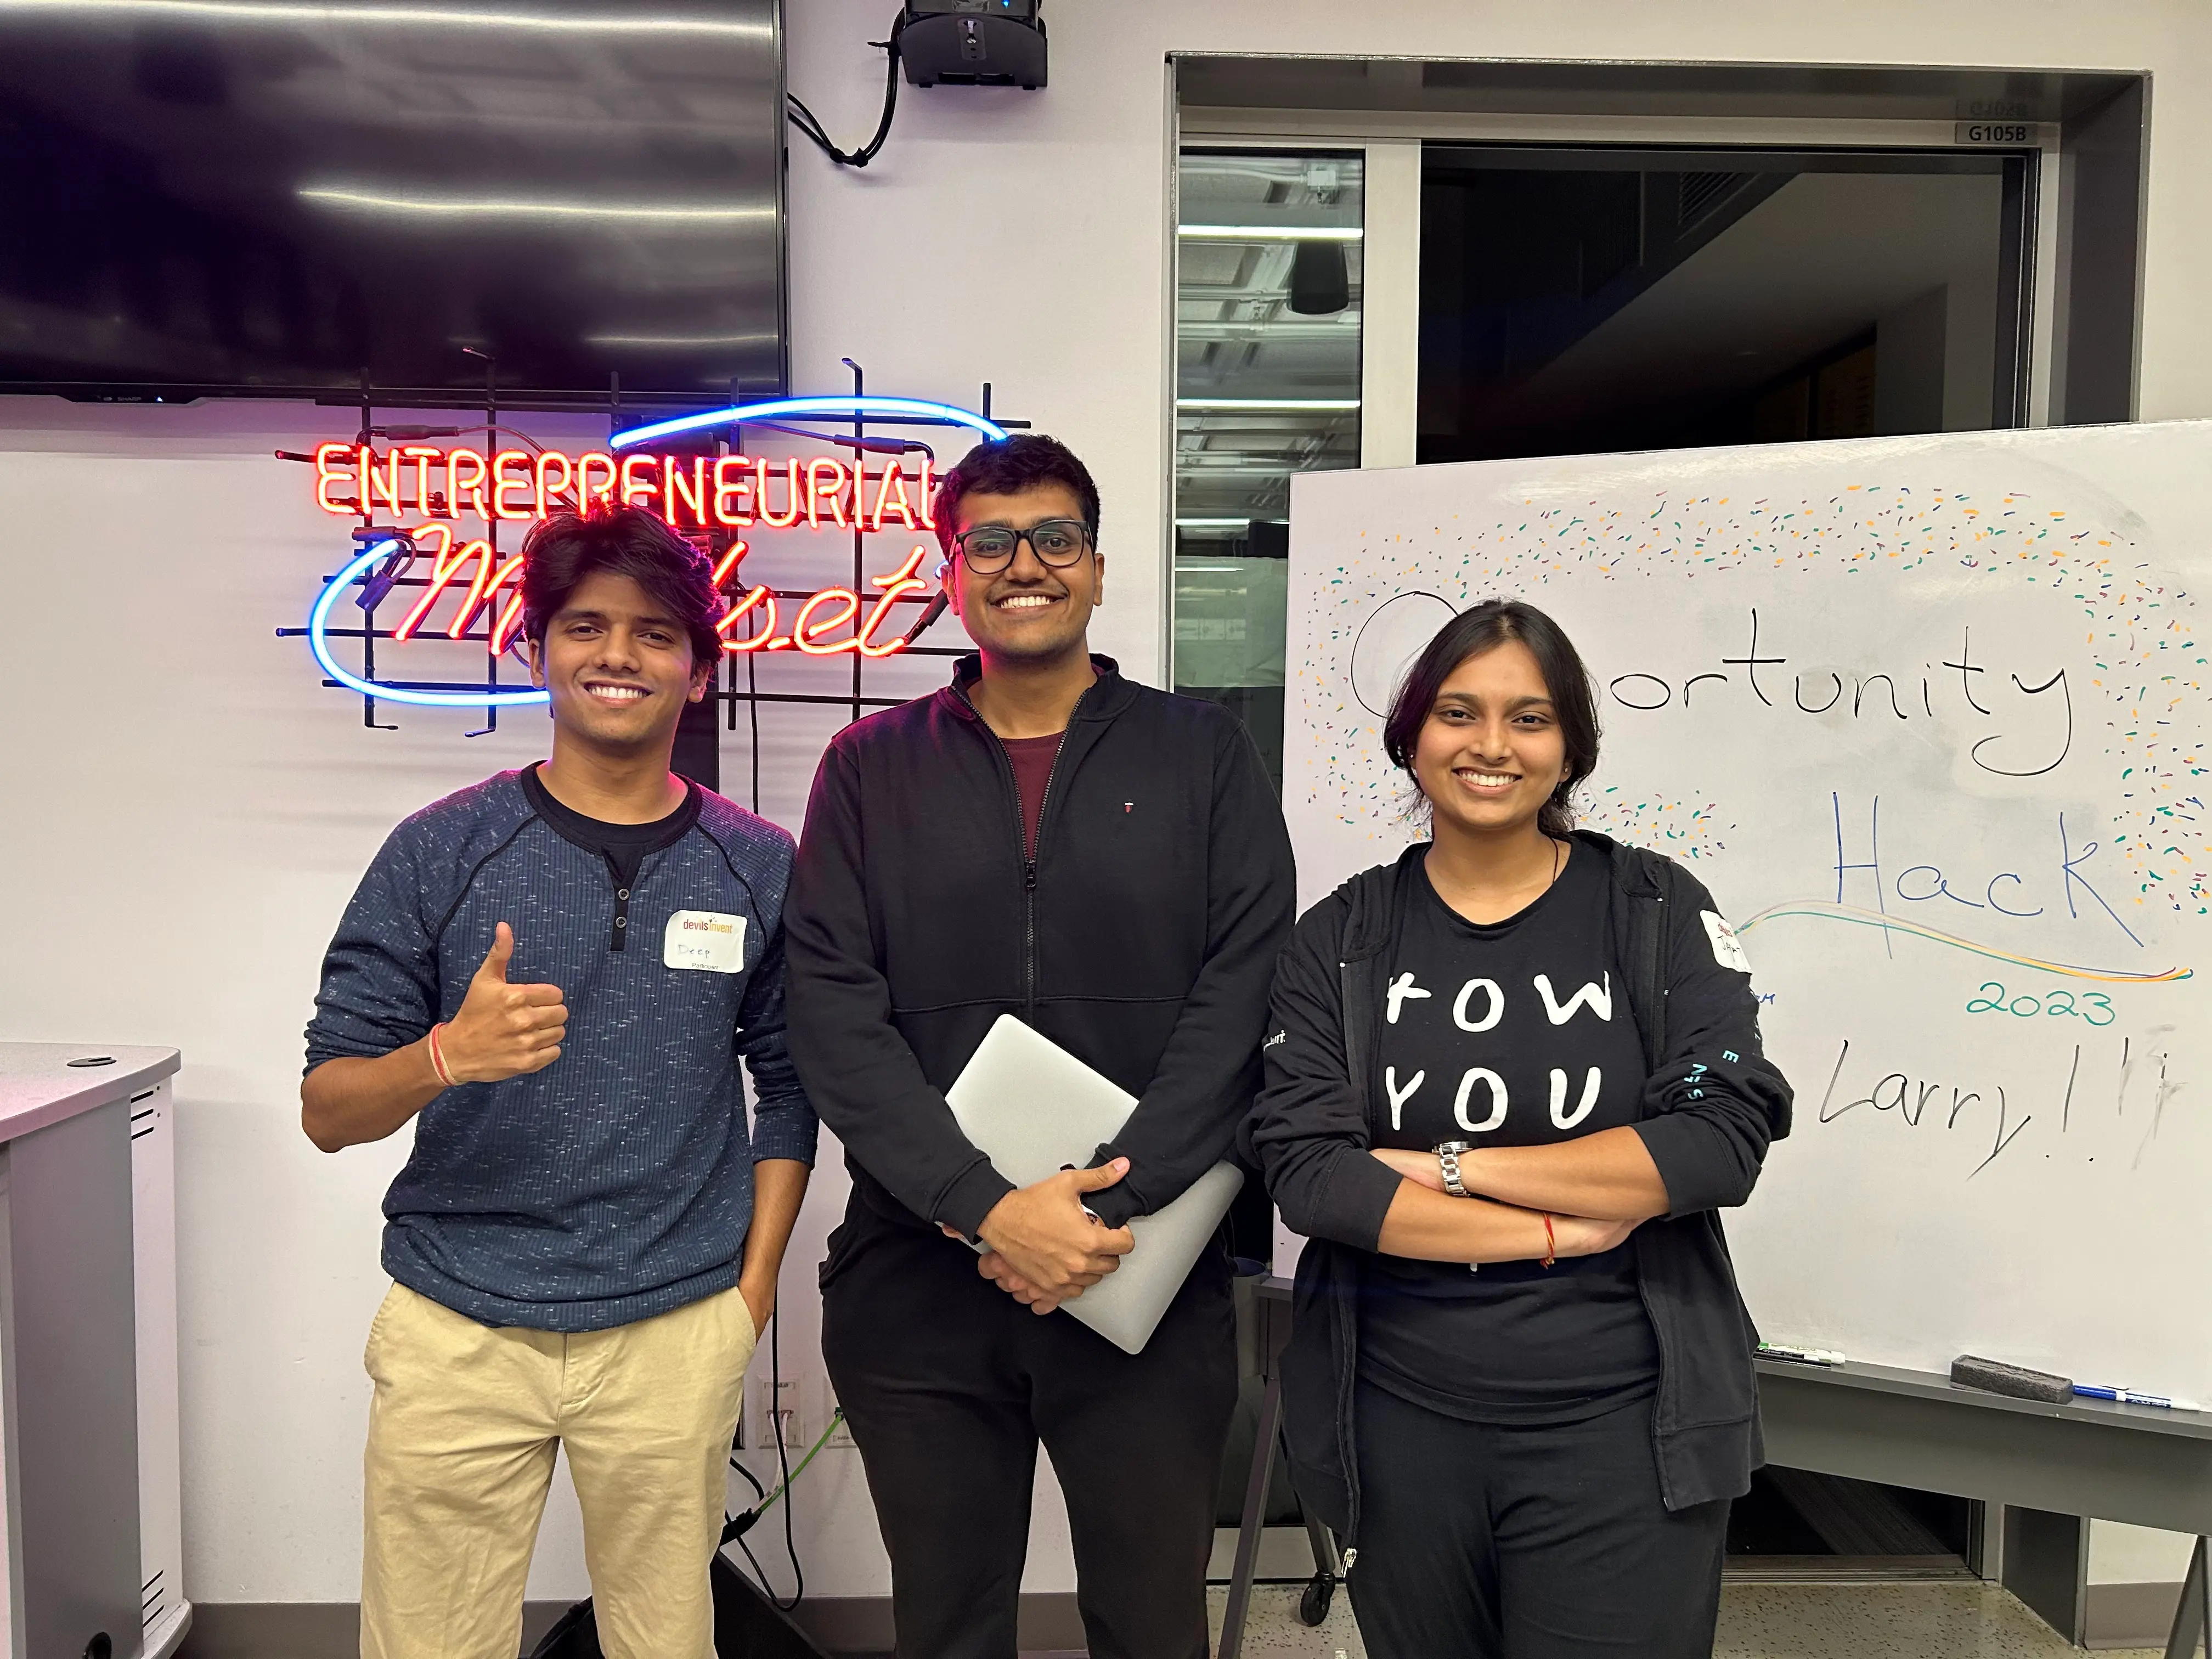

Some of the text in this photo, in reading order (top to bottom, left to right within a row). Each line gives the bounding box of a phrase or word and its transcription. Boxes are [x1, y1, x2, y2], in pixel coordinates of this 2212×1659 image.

[1969, 126, 2027, 141] G105B
[394, 522, 928, 657] Mset
[1351, 590, 2072, 777] Oortunity
[1966, 982, 2116, 1026] 2023
[1385, 1066, 1602, 1132] YOU
